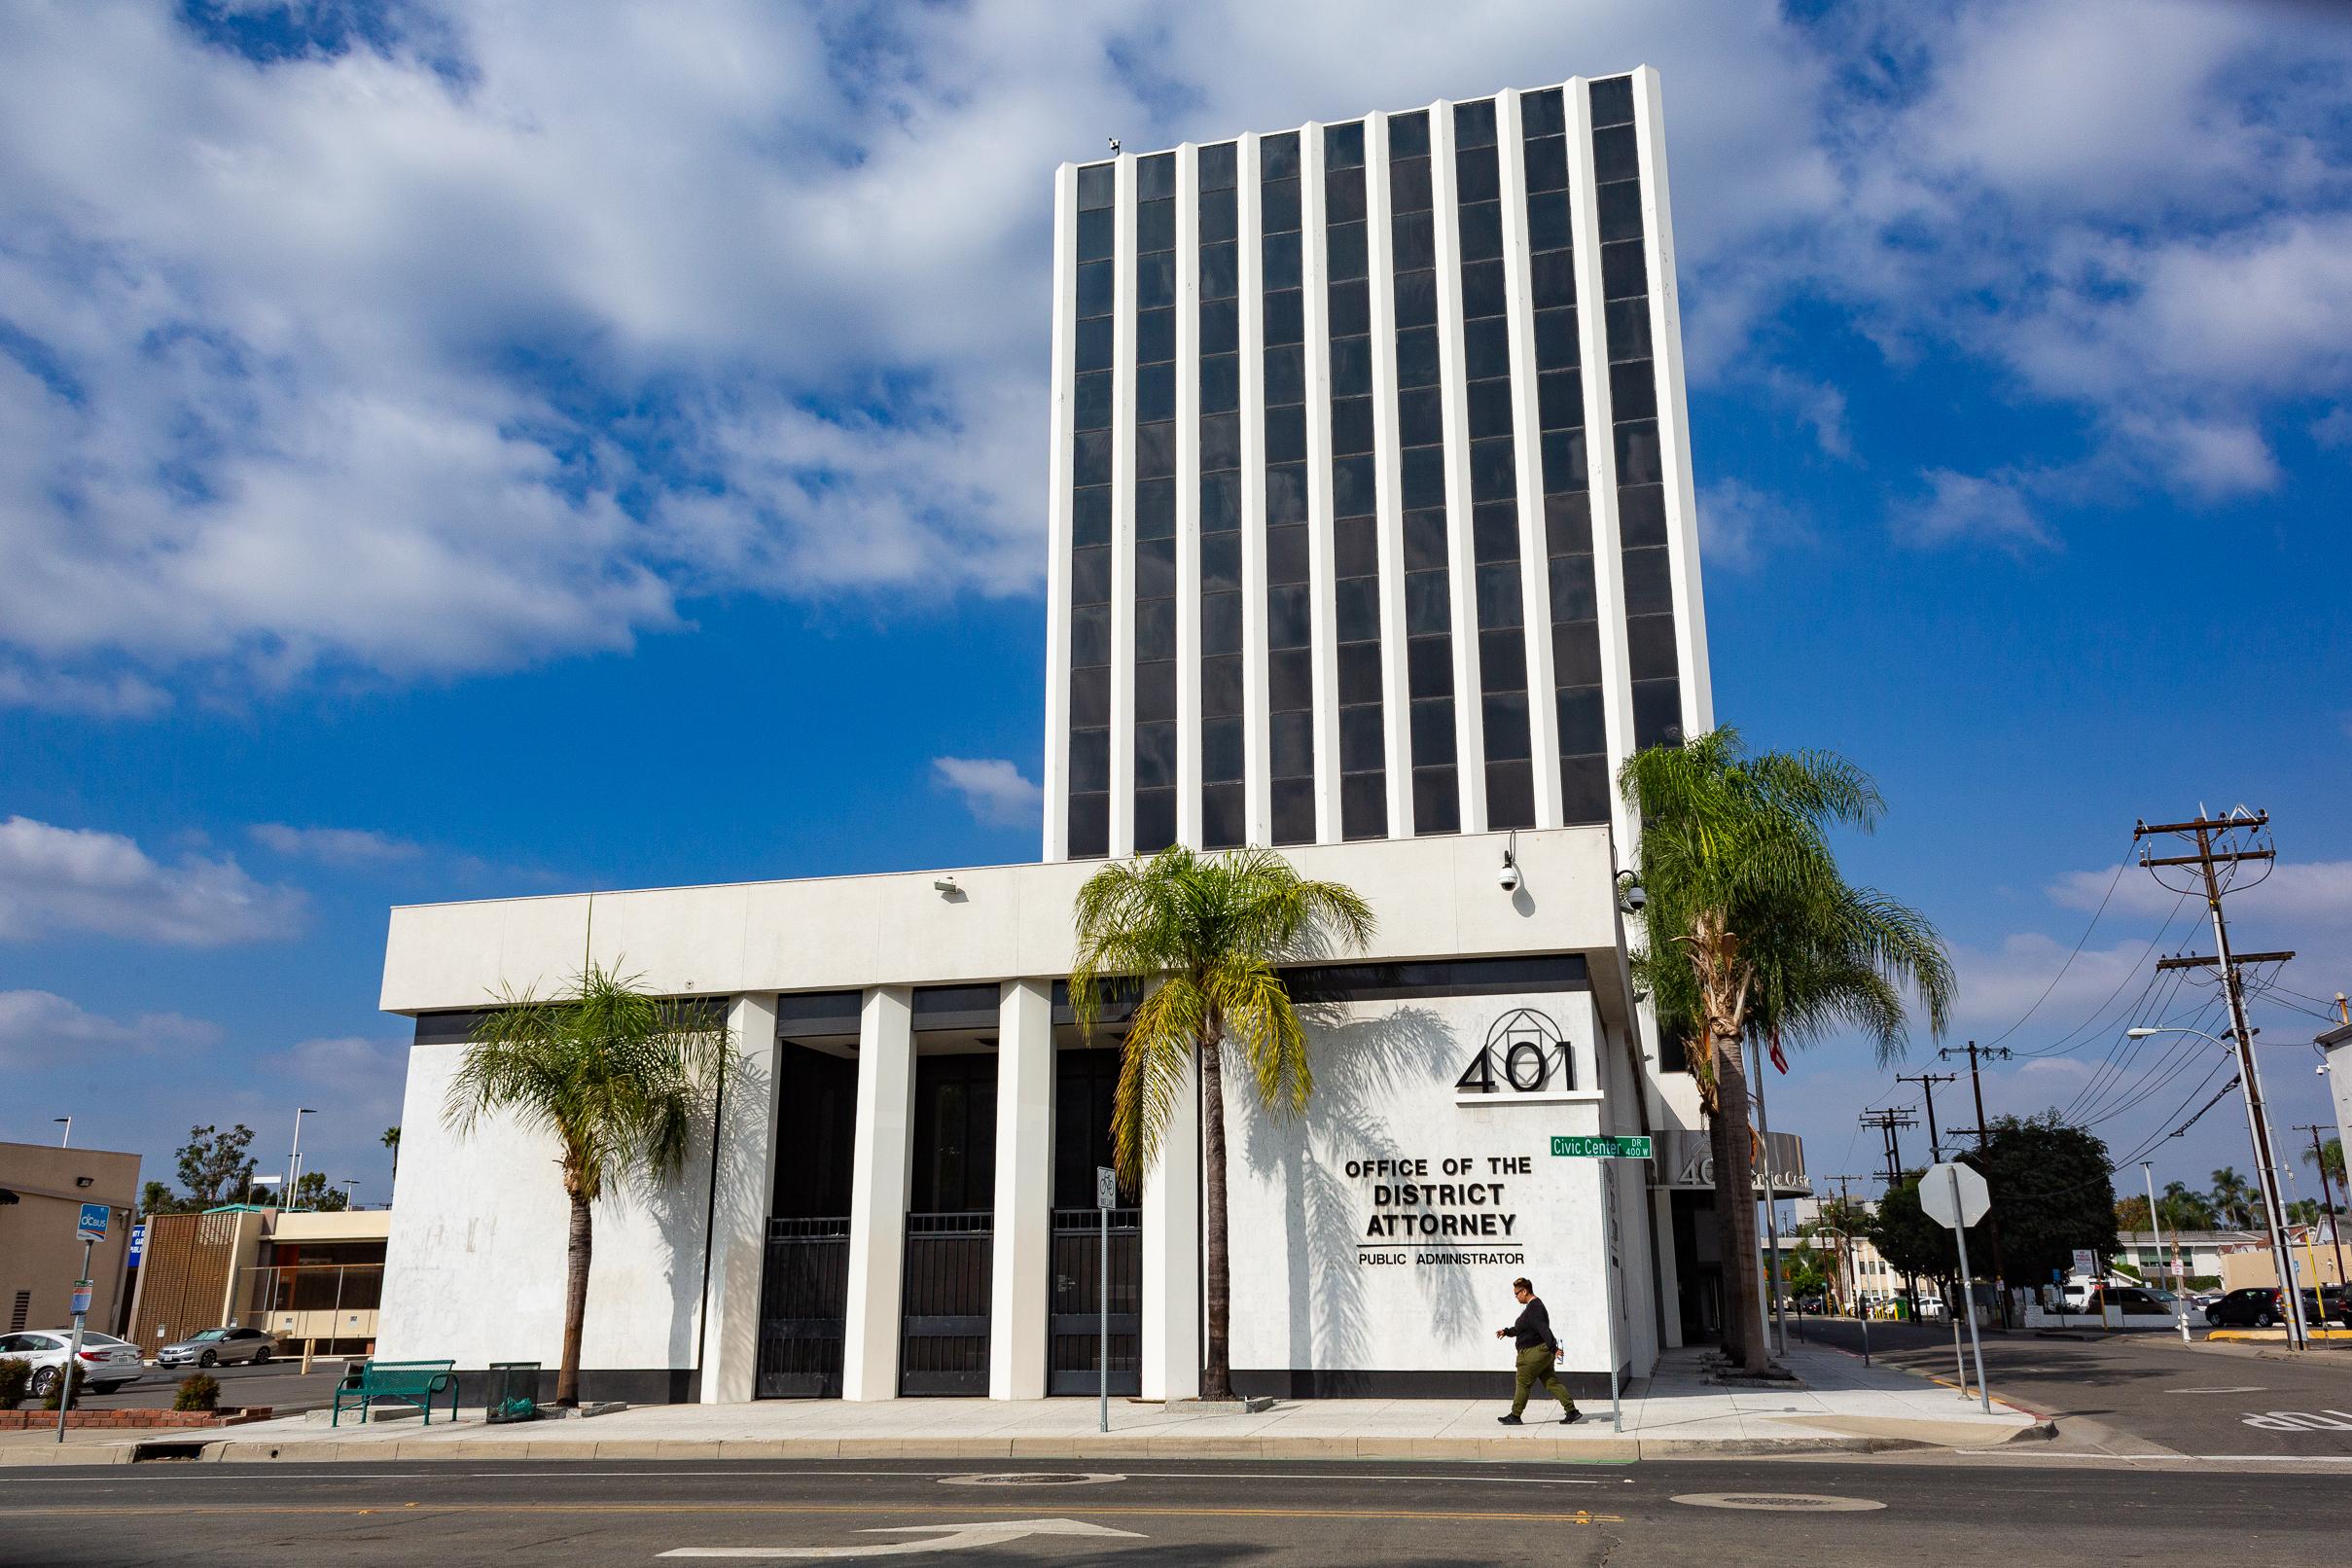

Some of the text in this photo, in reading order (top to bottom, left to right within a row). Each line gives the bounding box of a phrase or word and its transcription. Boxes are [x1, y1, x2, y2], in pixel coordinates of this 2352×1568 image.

[1454, 1041, 1577, 1093] 401
[1553, 1139, 1621, 1155] Civic Center
[1625, 1148, 1649, 1157] 400 W
[1345, 1156, 1532, 1178] OFFICE OF THE
[1679, 1158, 1715, 1185] 40
[1373, 1183, 1505, 1206] DISTRICT
[1366, 1213, 1517, 1236] ATTORNEY
[1359, 1253, 1525, 1265] PUBLIC ADMINISTRATOR
